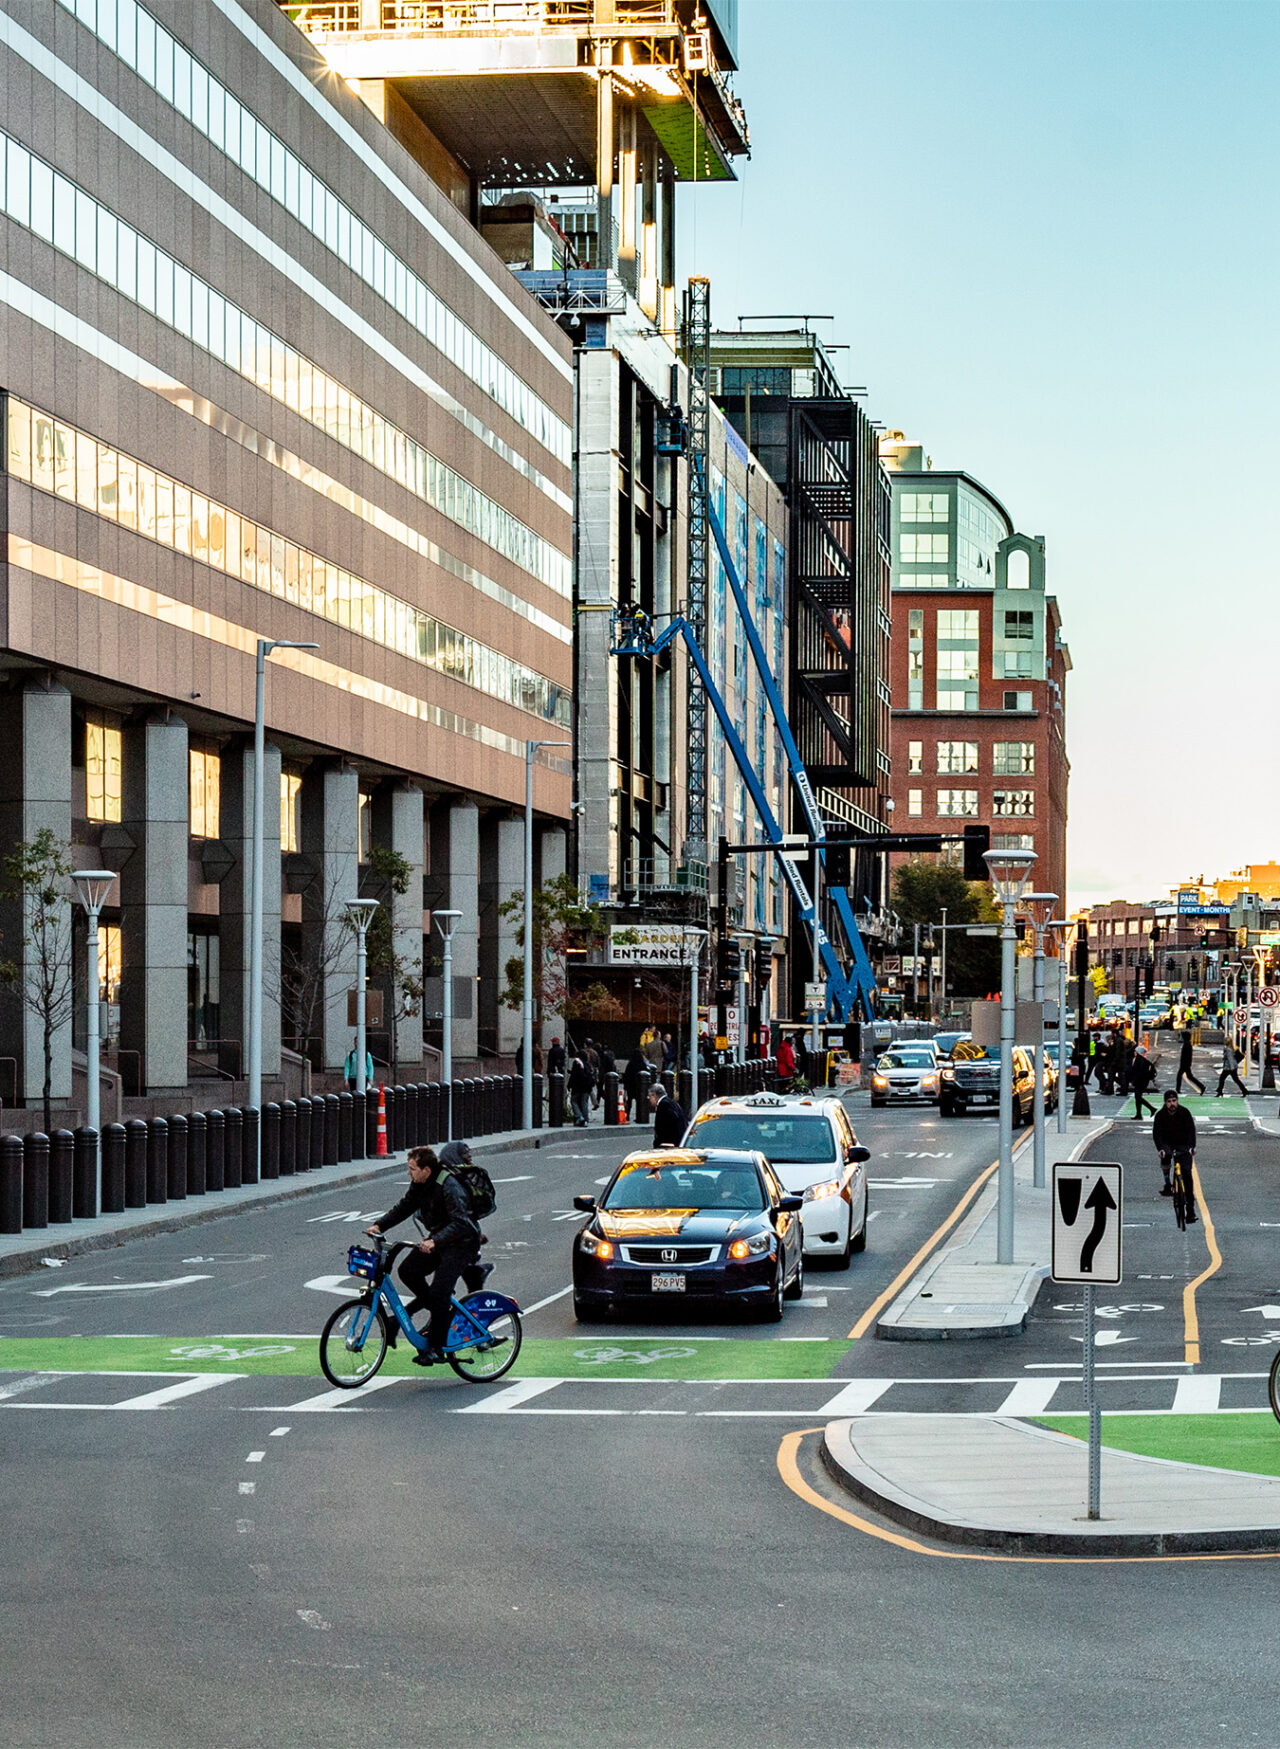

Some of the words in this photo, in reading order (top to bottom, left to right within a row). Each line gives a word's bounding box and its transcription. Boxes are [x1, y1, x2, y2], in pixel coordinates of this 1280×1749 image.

[802, 784, 813, 810] United
[795, 878, 809, 906] Rentals
[1180, 894, 1198, 903] PARK
[613, 949, 687, 960] ENTRANCE
[751, 1098, 779, 1106] TAXI
[653, 1277, 668, 1288] 296
